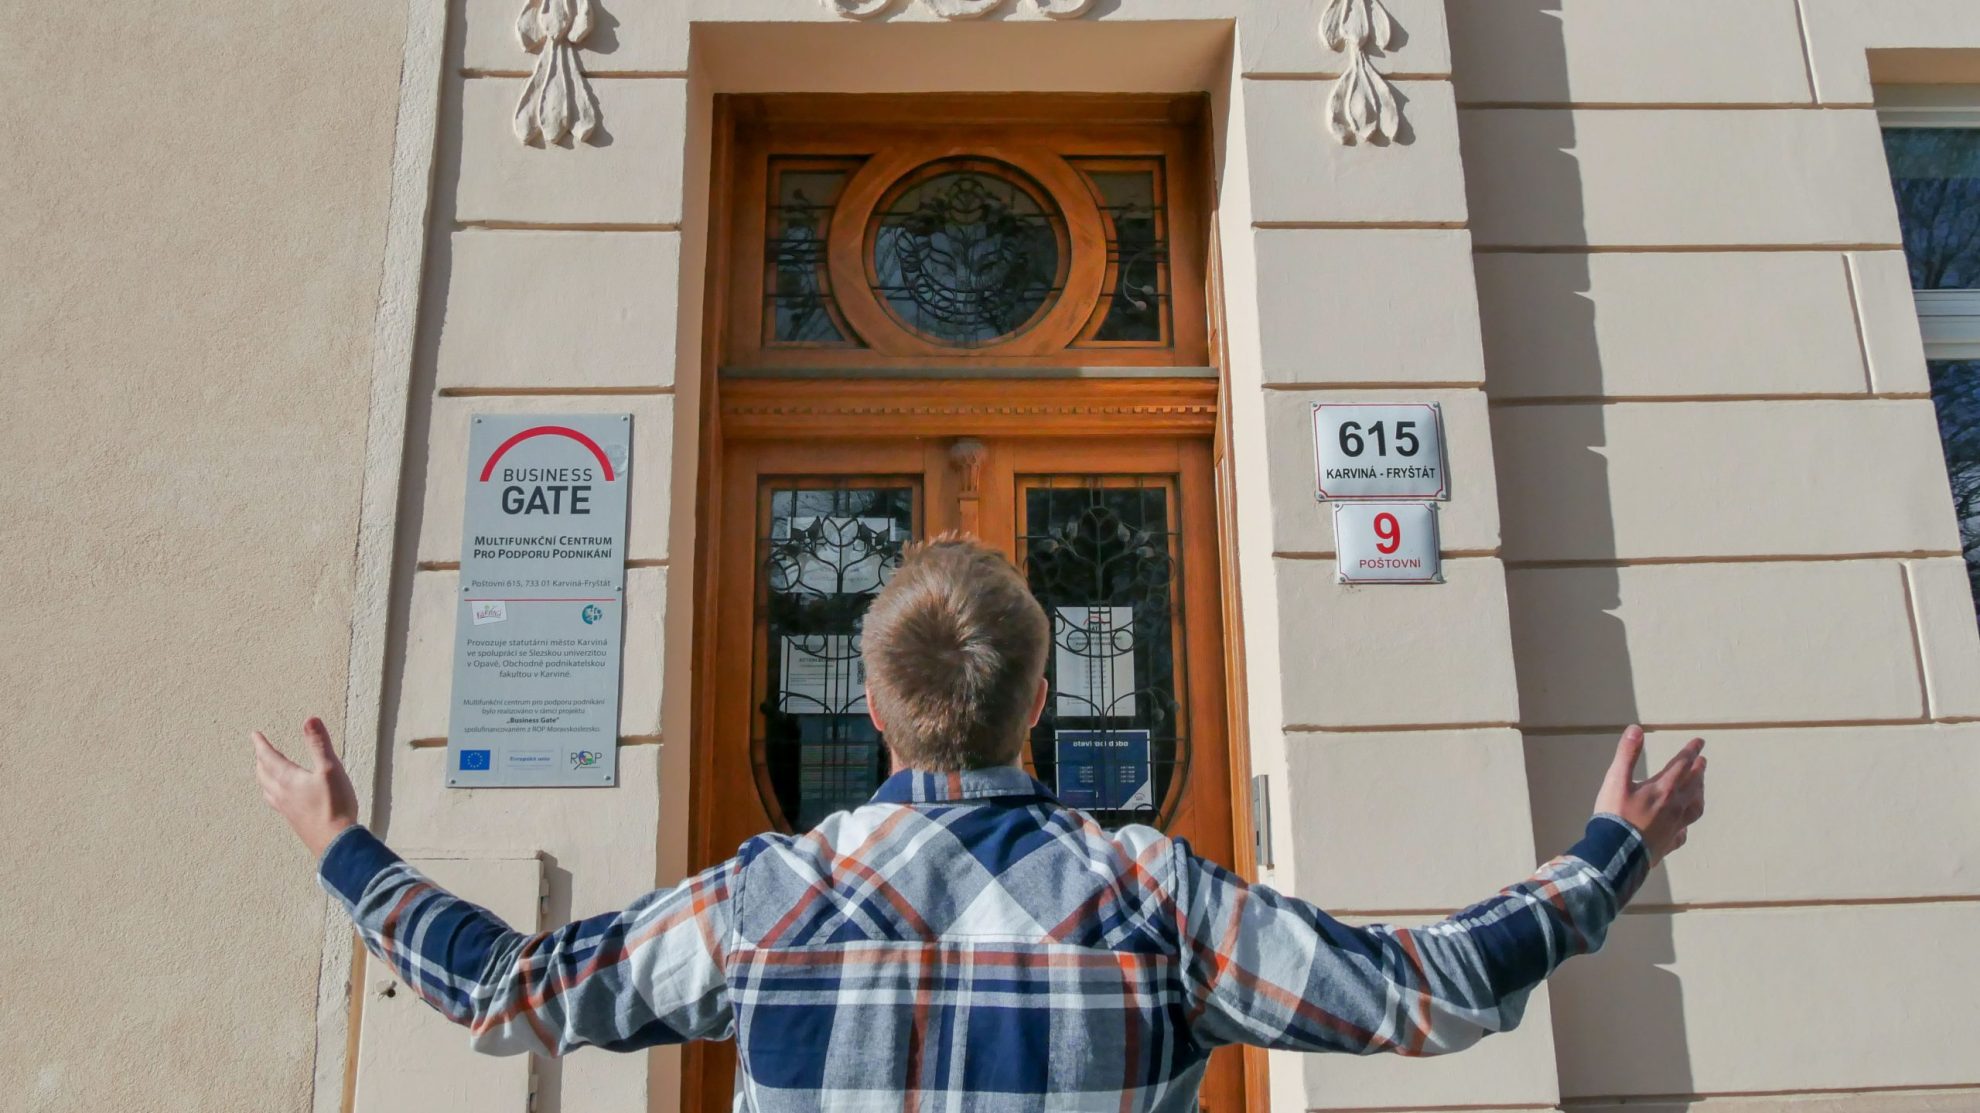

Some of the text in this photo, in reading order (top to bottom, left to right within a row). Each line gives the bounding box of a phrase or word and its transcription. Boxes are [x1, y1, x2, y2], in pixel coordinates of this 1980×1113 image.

[1338, 421, 1419, 457] 615
[503, 468, 593, 482] BUSINESS
[1326, 465, 1377, 479] KARVINÁ
[1386, 466, 1436, 479] FRYŠTÁT
[501, 485, 592, 515] GATE
[1373, 512, 1401, 554] 9
[498, 549, 550, 559] PODPORU
[1359, 557, 1421, 569] POŠTOVNÍ
[471, 580, 505, 588] Poštovní
[506, 580, 523, 588] 615,
[467, 639, 507, 647] Provozuje
[508, 638, 548, 646] statutární
[550, 638, 575, 646] město
[478, 649, 518, 658] spolupráci
[529, 649, 562, 657] Slezskou
[563, 649, 607, 657] univerzitou
[545, 659, 606, 668] podnikatelskou
[499, 670, 532, 678] fakultou
